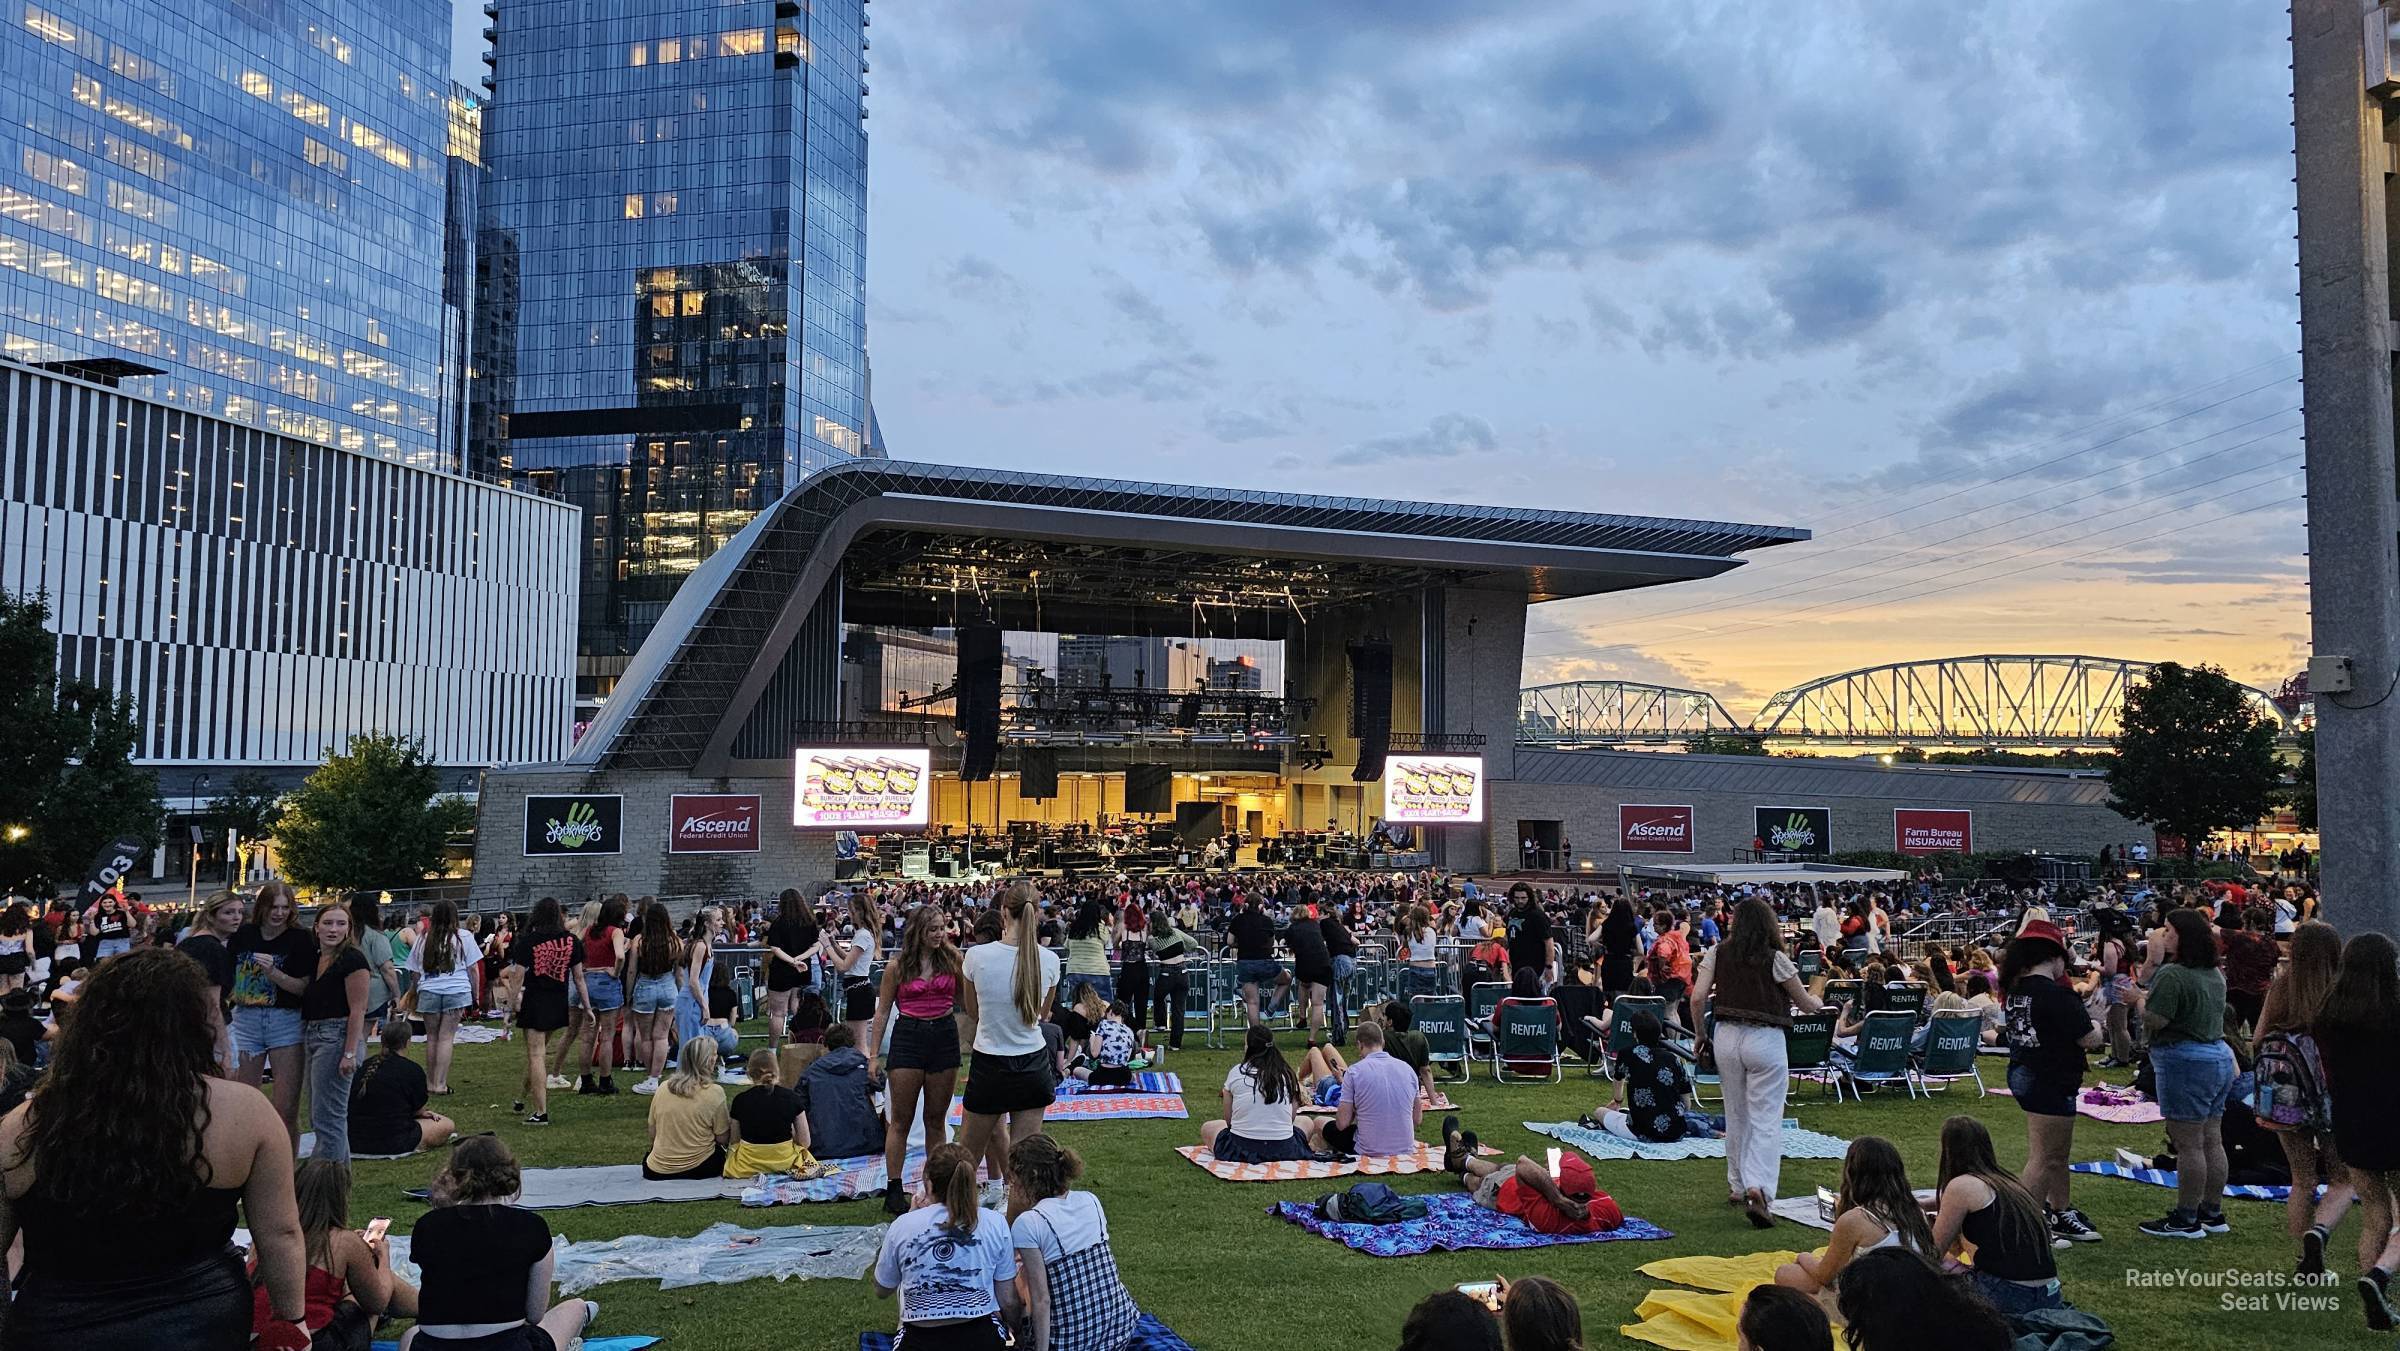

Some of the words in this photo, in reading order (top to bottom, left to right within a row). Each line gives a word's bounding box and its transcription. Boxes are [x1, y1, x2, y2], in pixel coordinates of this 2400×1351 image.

[680, 816, 751, 832] Ascend
[1627, 822, 1685, 836] Ascend
[1905, 828, 1929, 836] Farm
[1930, 829, 1963, 837] Bureau
[1905, 838, 1963, 847] INSURANCE
[88, 855, 133, 894] 103
[1829, 992, 1855, 1001] RENTAL
[1891, 995, 1919, 1003] RENTAL
[1419, 1020, 1455, 1034] RENTAL
[1511, 1022, 1547, 1036] RENTAL
[1793, 1023, 1827, 1033] RENTAL
[1869, 1037, 1903, 1051] RENTAL
[1937, 1037, 1971, 1050] RENTAL
